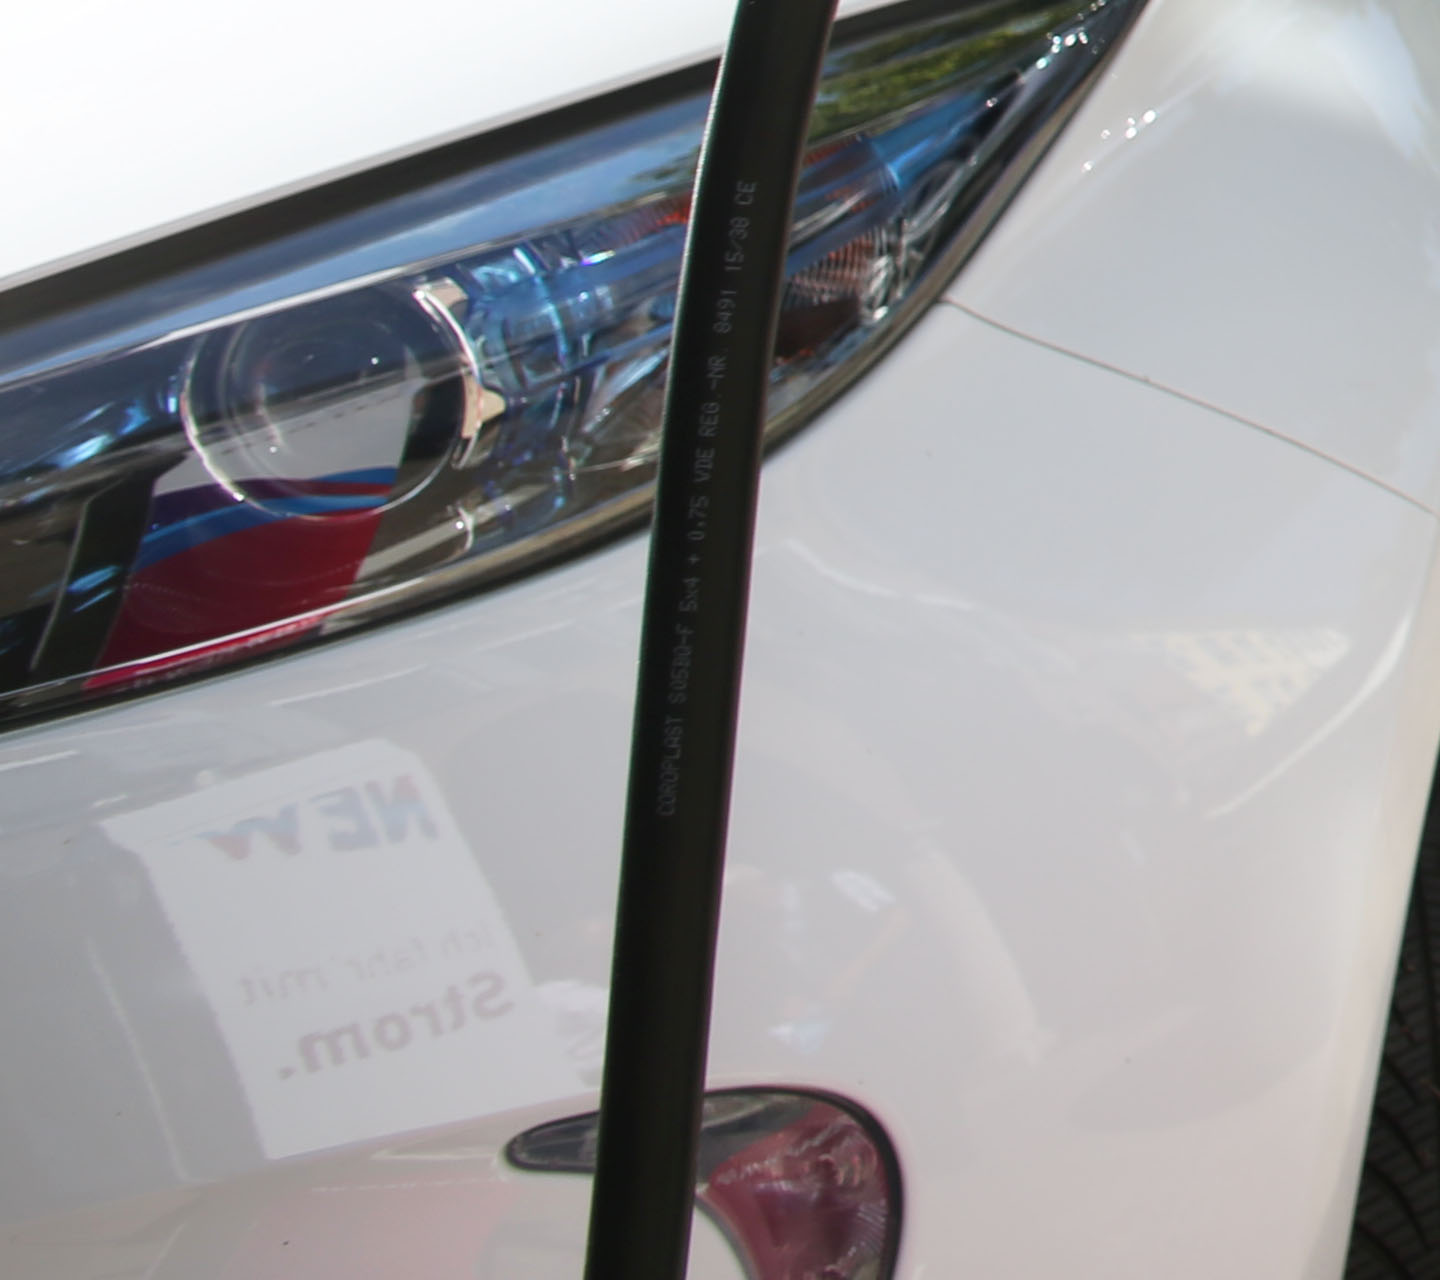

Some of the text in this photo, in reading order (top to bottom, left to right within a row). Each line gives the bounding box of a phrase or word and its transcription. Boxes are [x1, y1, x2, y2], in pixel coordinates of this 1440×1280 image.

[656, 715, 685, 817] COROPLAST
[692, 447, 716, 484] VDE
[712, 288, 738, 334] 8491
